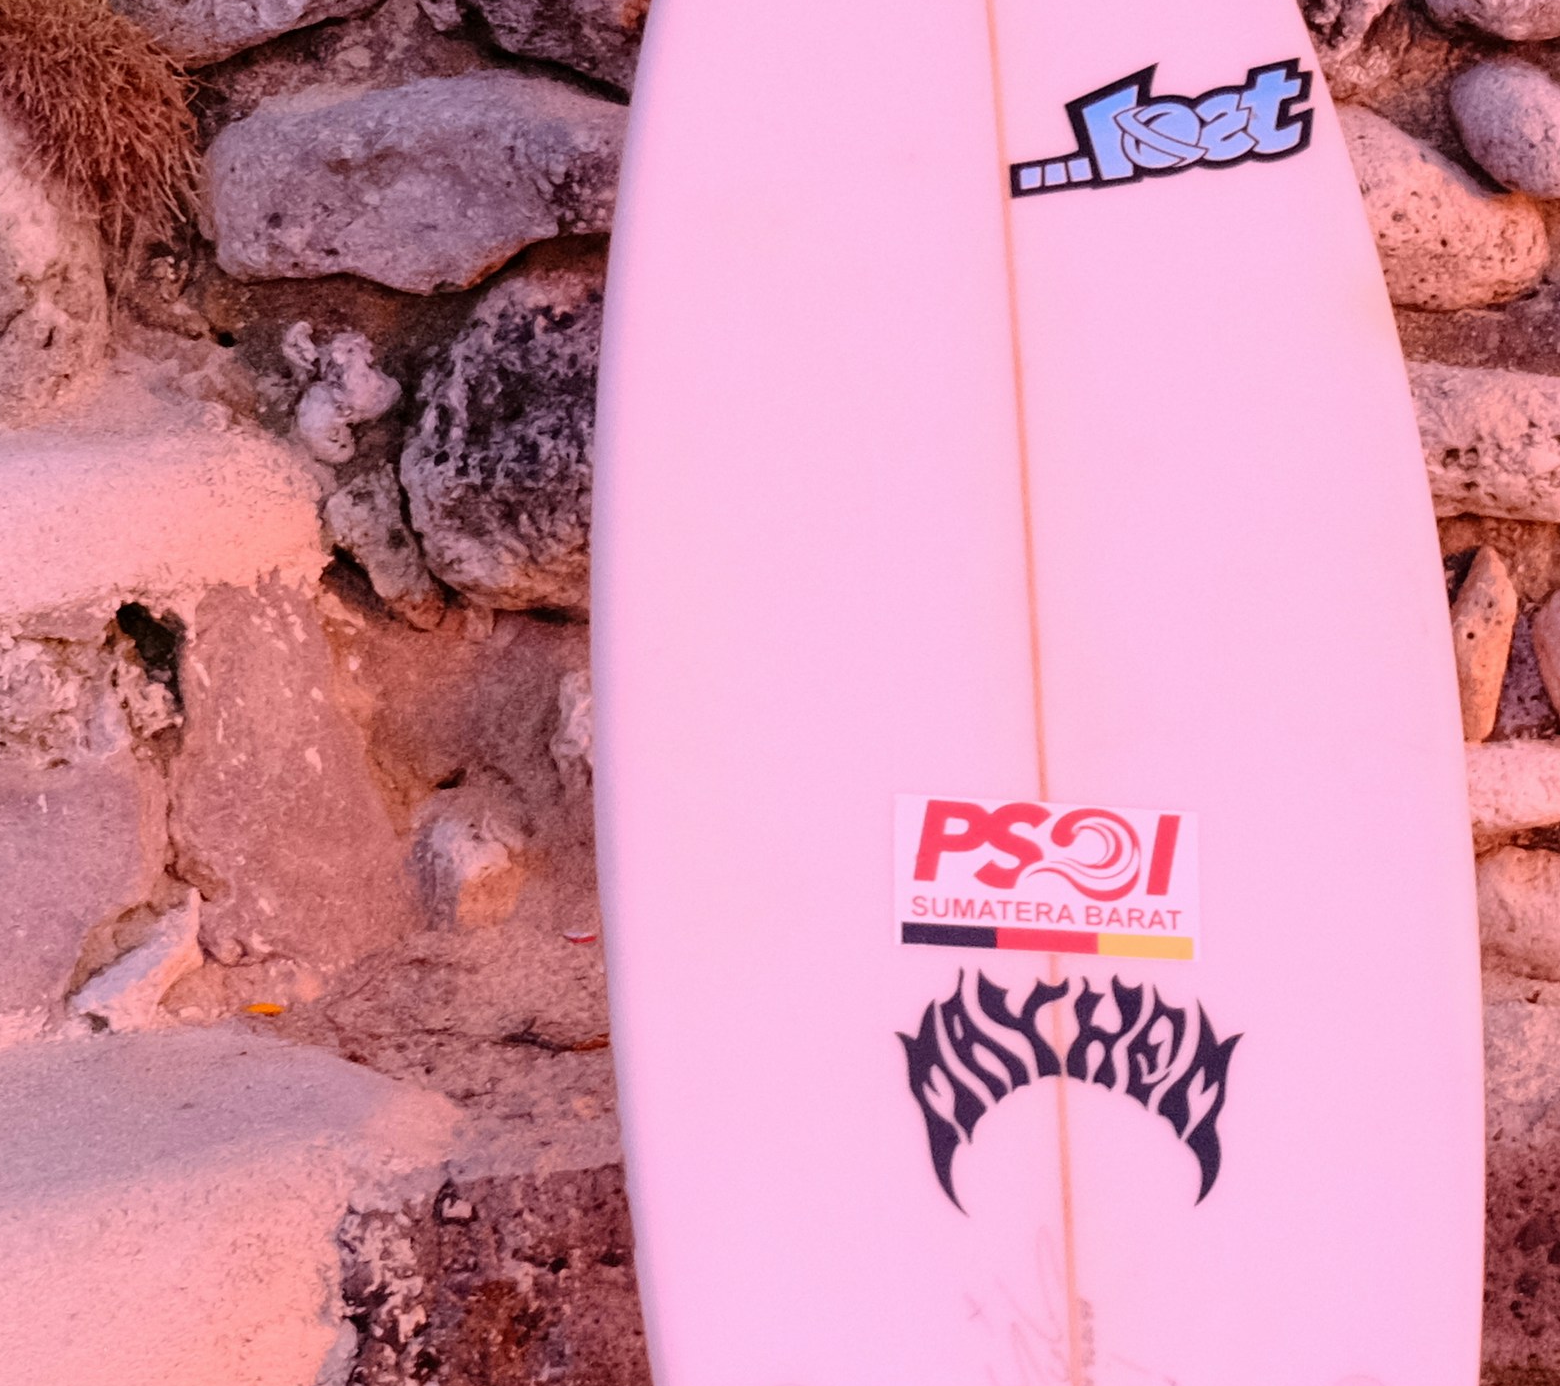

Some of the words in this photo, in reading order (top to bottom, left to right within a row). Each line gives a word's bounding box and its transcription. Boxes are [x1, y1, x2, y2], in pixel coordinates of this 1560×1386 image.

[913, 798, 1181, 903] PSOI
[911, 895, 1075, 925] SUMATERA
[1084, 904, 1183, 931] BARAT
[894, 966, 1246, 1218] MAYHEM
